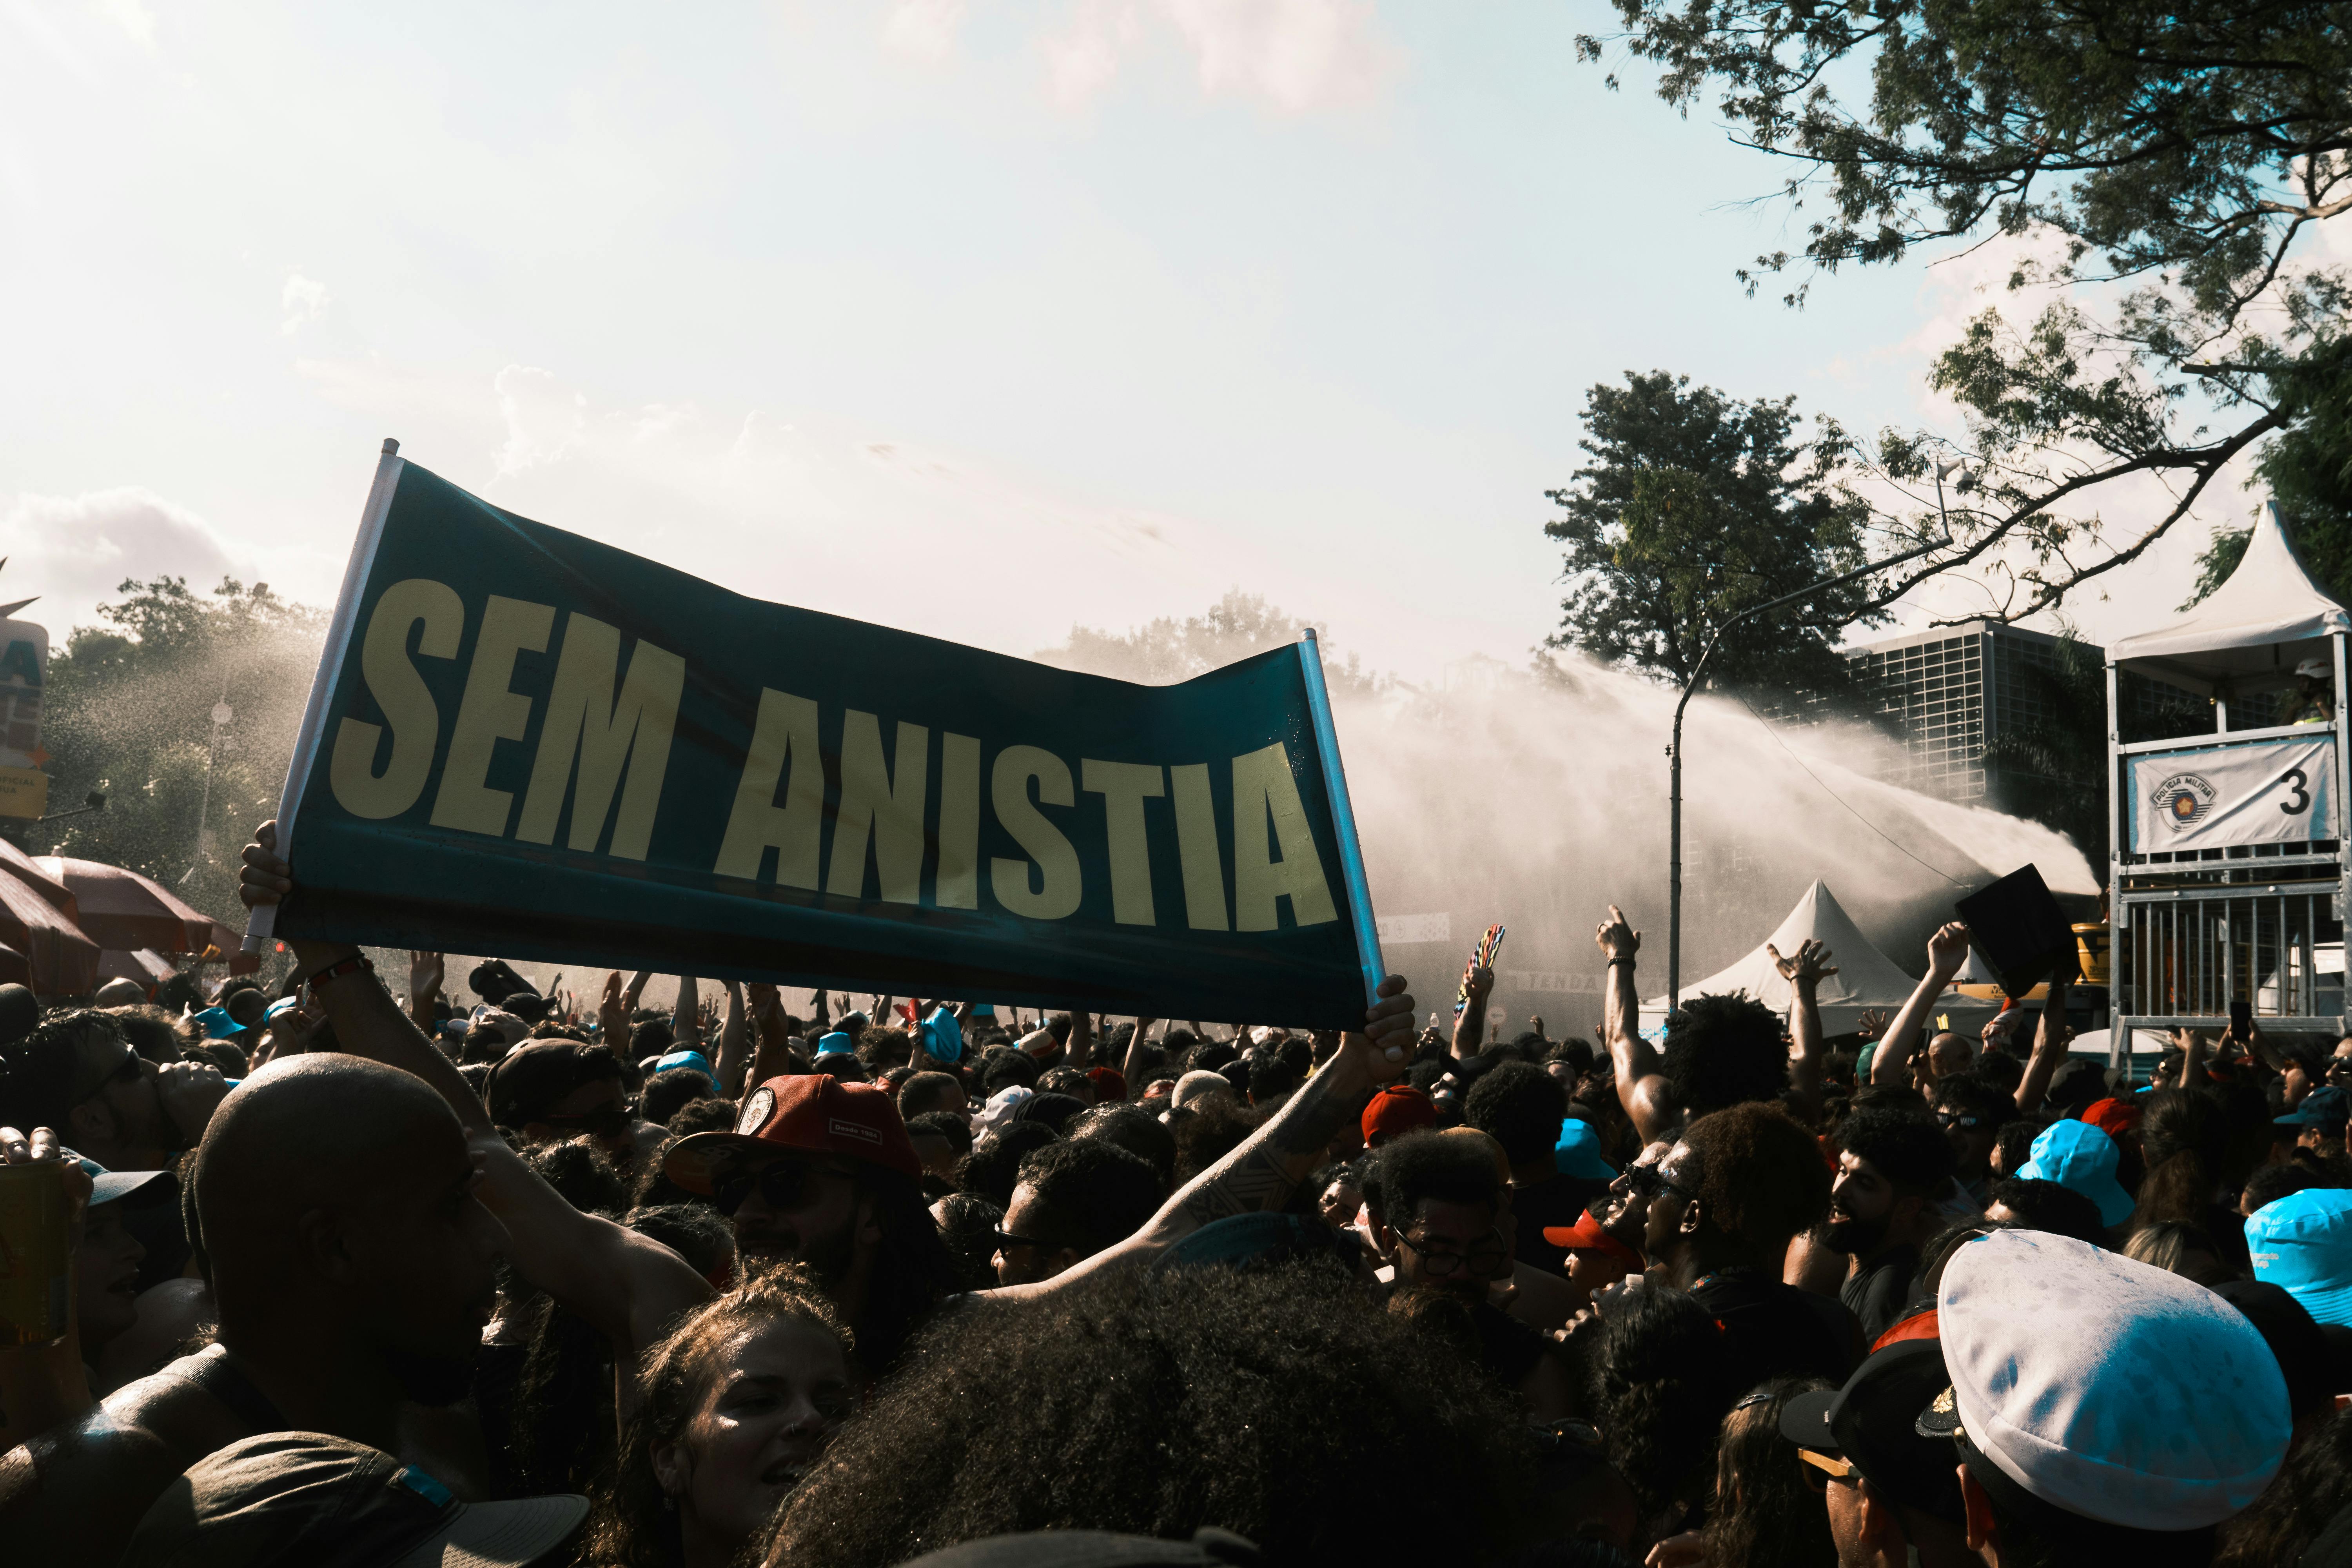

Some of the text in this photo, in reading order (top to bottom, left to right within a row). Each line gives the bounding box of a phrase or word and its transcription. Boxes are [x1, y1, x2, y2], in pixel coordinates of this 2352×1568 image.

[330, 579, 1338, 932] SEM ANISTIA
[0, 776, 35, 786] FICIAL
[2185, 777, 2212, 797] MILITAR
[2280, 768, 2310, 815] 3
[1528, 973, 1598, 991] TENDA
[835, 1124, 878, 1138] Desde 1984
